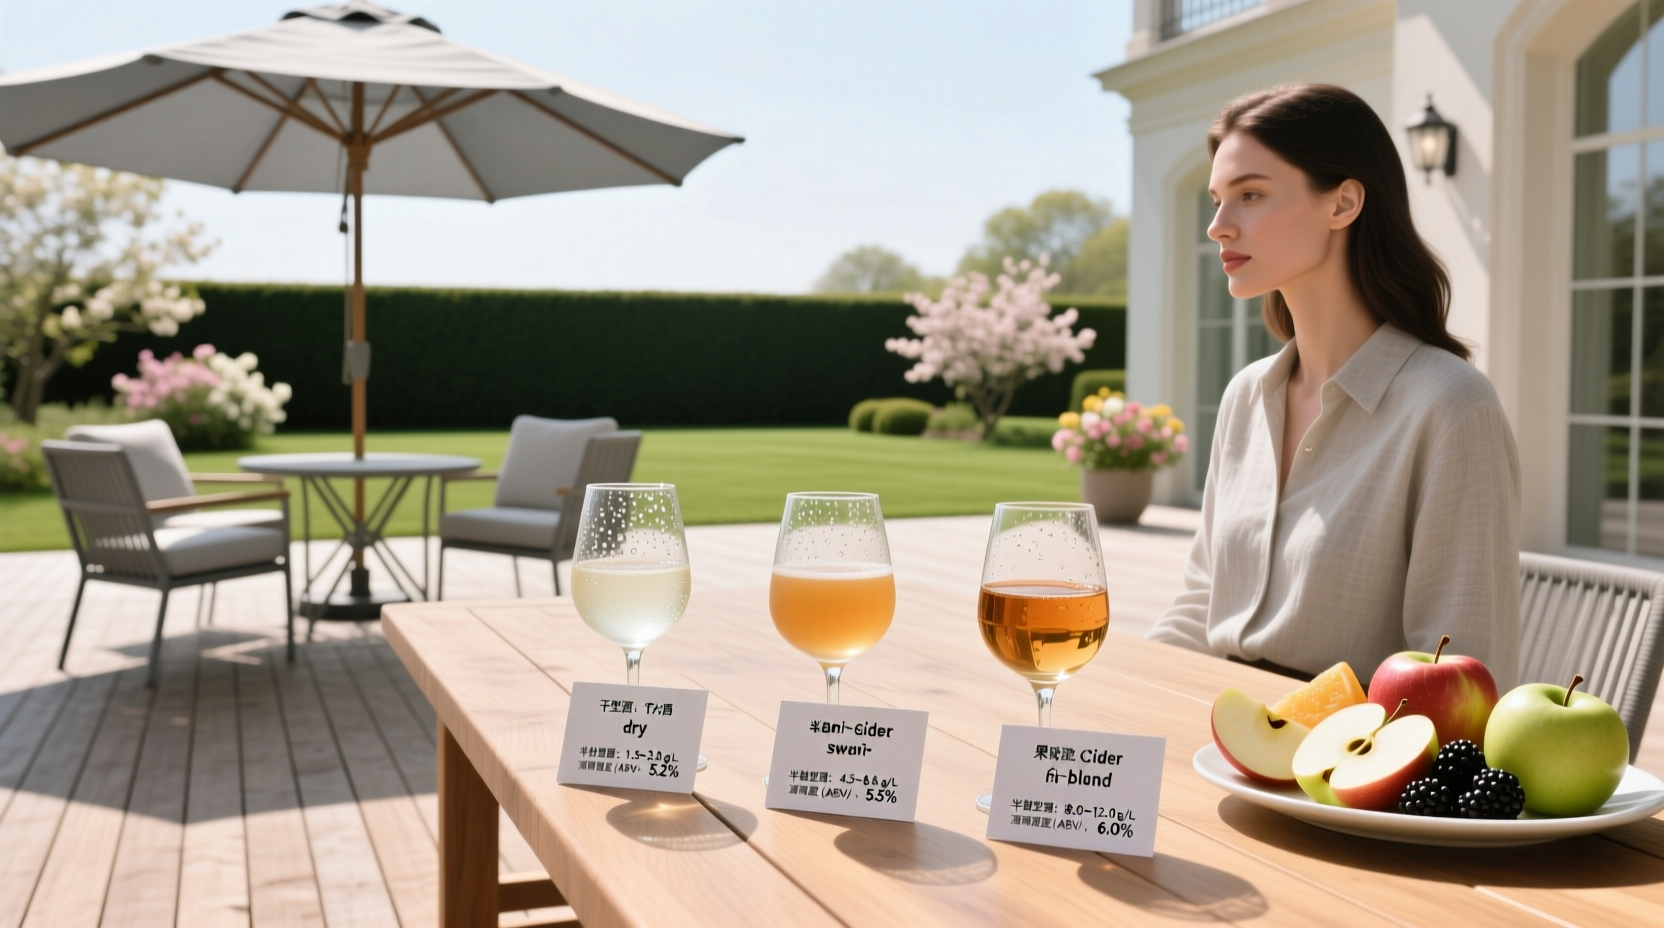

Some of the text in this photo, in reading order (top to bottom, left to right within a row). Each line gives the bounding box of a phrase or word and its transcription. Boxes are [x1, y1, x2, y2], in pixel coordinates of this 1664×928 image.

[622, 719, 648, 739] dry
[1079, 748, 1123, 765] Cider
[865, 788, 897, 804] 5.5%
[1097, 821, 1134, 838] 6.0%
